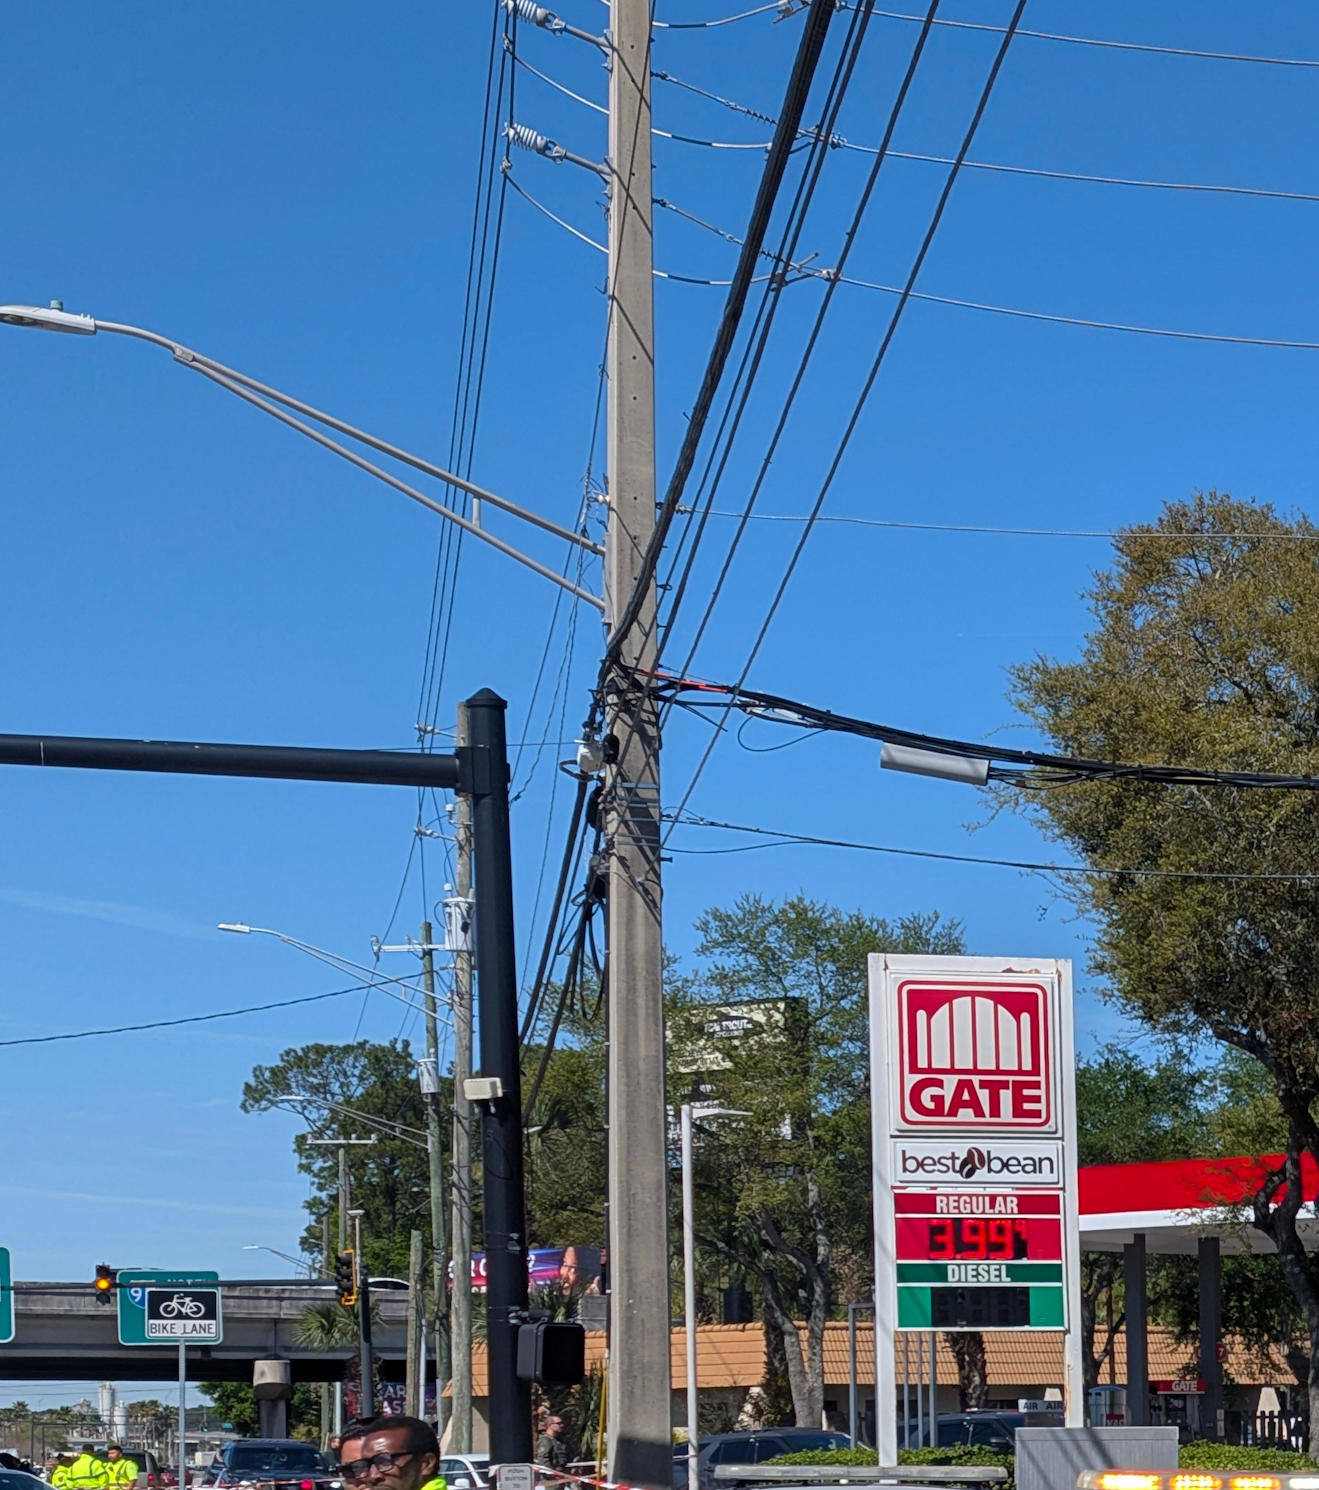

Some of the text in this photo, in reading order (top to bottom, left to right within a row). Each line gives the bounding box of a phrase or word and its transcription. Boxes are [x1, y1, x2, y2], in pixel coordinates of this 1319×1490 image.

[909, 1077, 1042, 1119] GATE
[901, 1149, 1054, 1174] best bean
[936, 1196, 1018, 1214] REGULAR
[947, 1265, 1011, 1282] DIESEL
[150, 1323, 215, 1335] BIKE LANE
[1171, 1380, 1198, 1392] GATE
